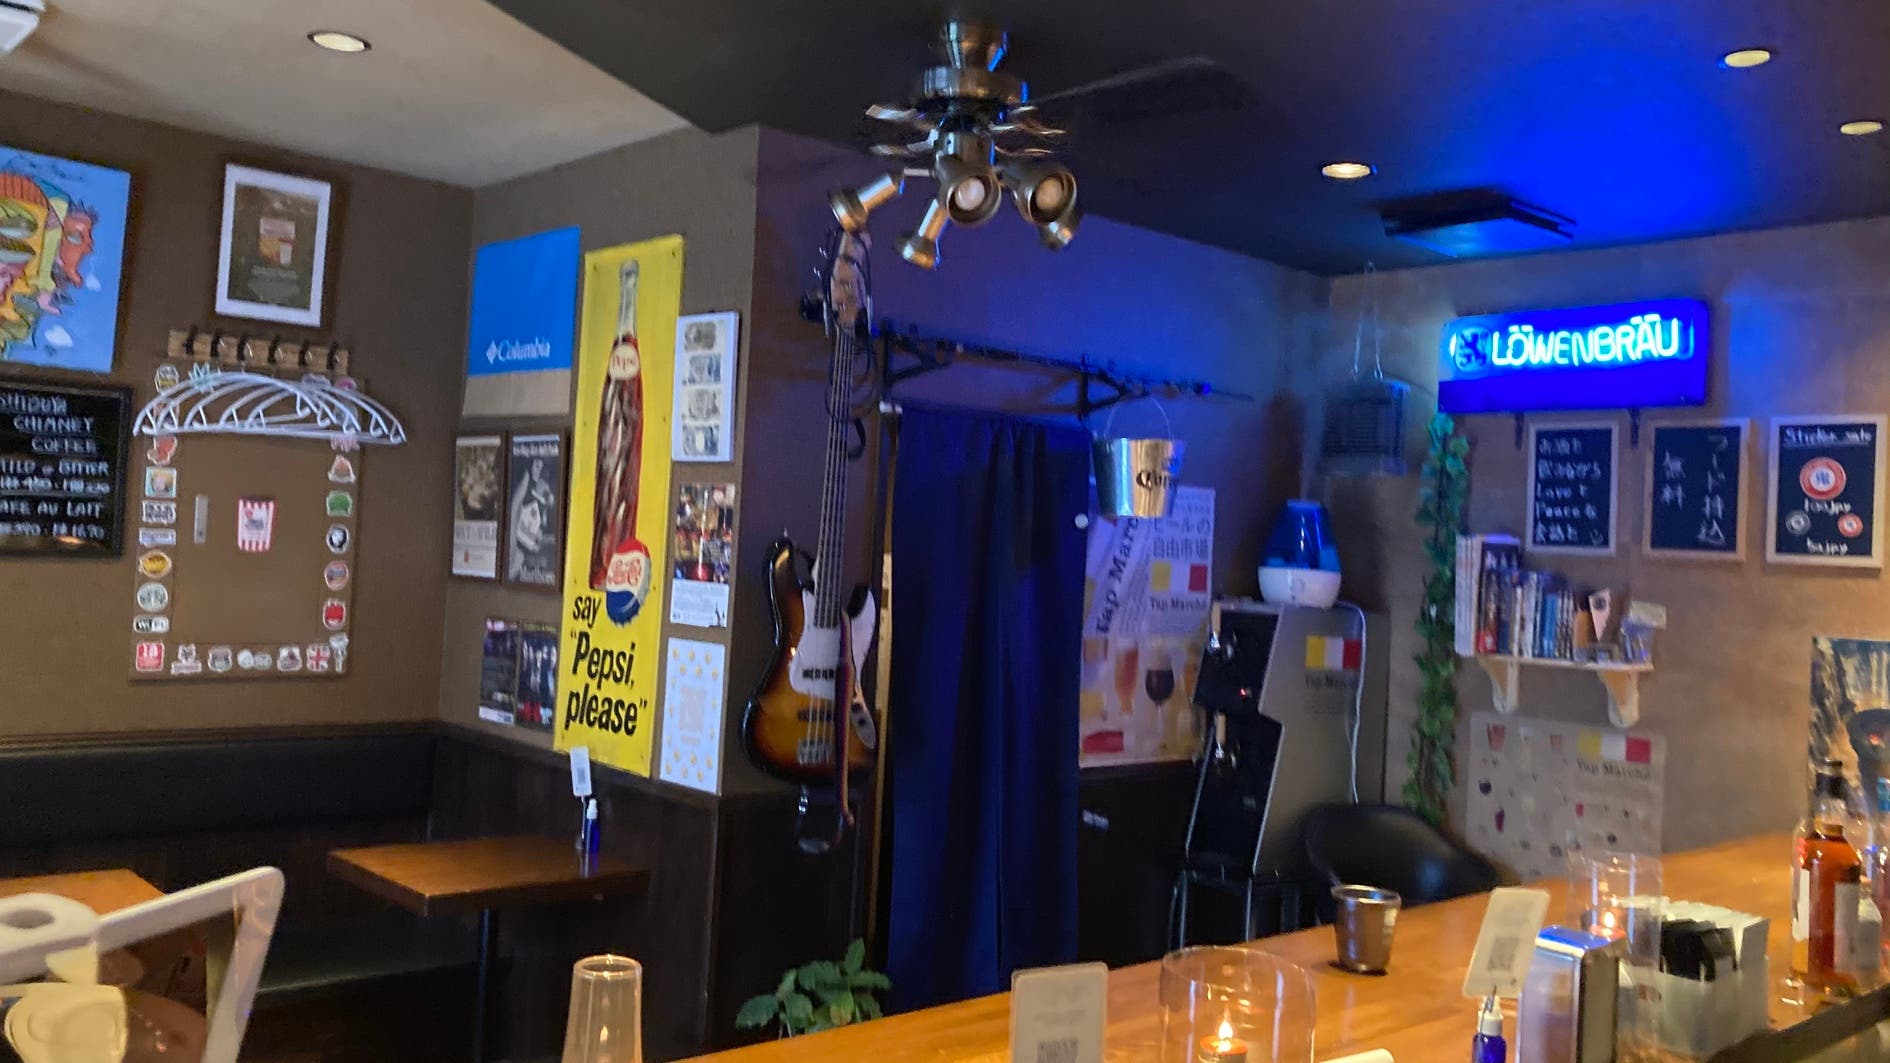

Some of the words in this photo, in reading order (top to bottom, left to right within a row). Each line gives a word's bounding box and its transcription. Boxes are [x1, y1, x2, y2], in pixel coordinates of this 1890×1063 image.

[498, 336, 551, 362] Columbia
[1491, 313, 1679, 367] LÖWENBRÄU
[572, 594, 601, 628] say
